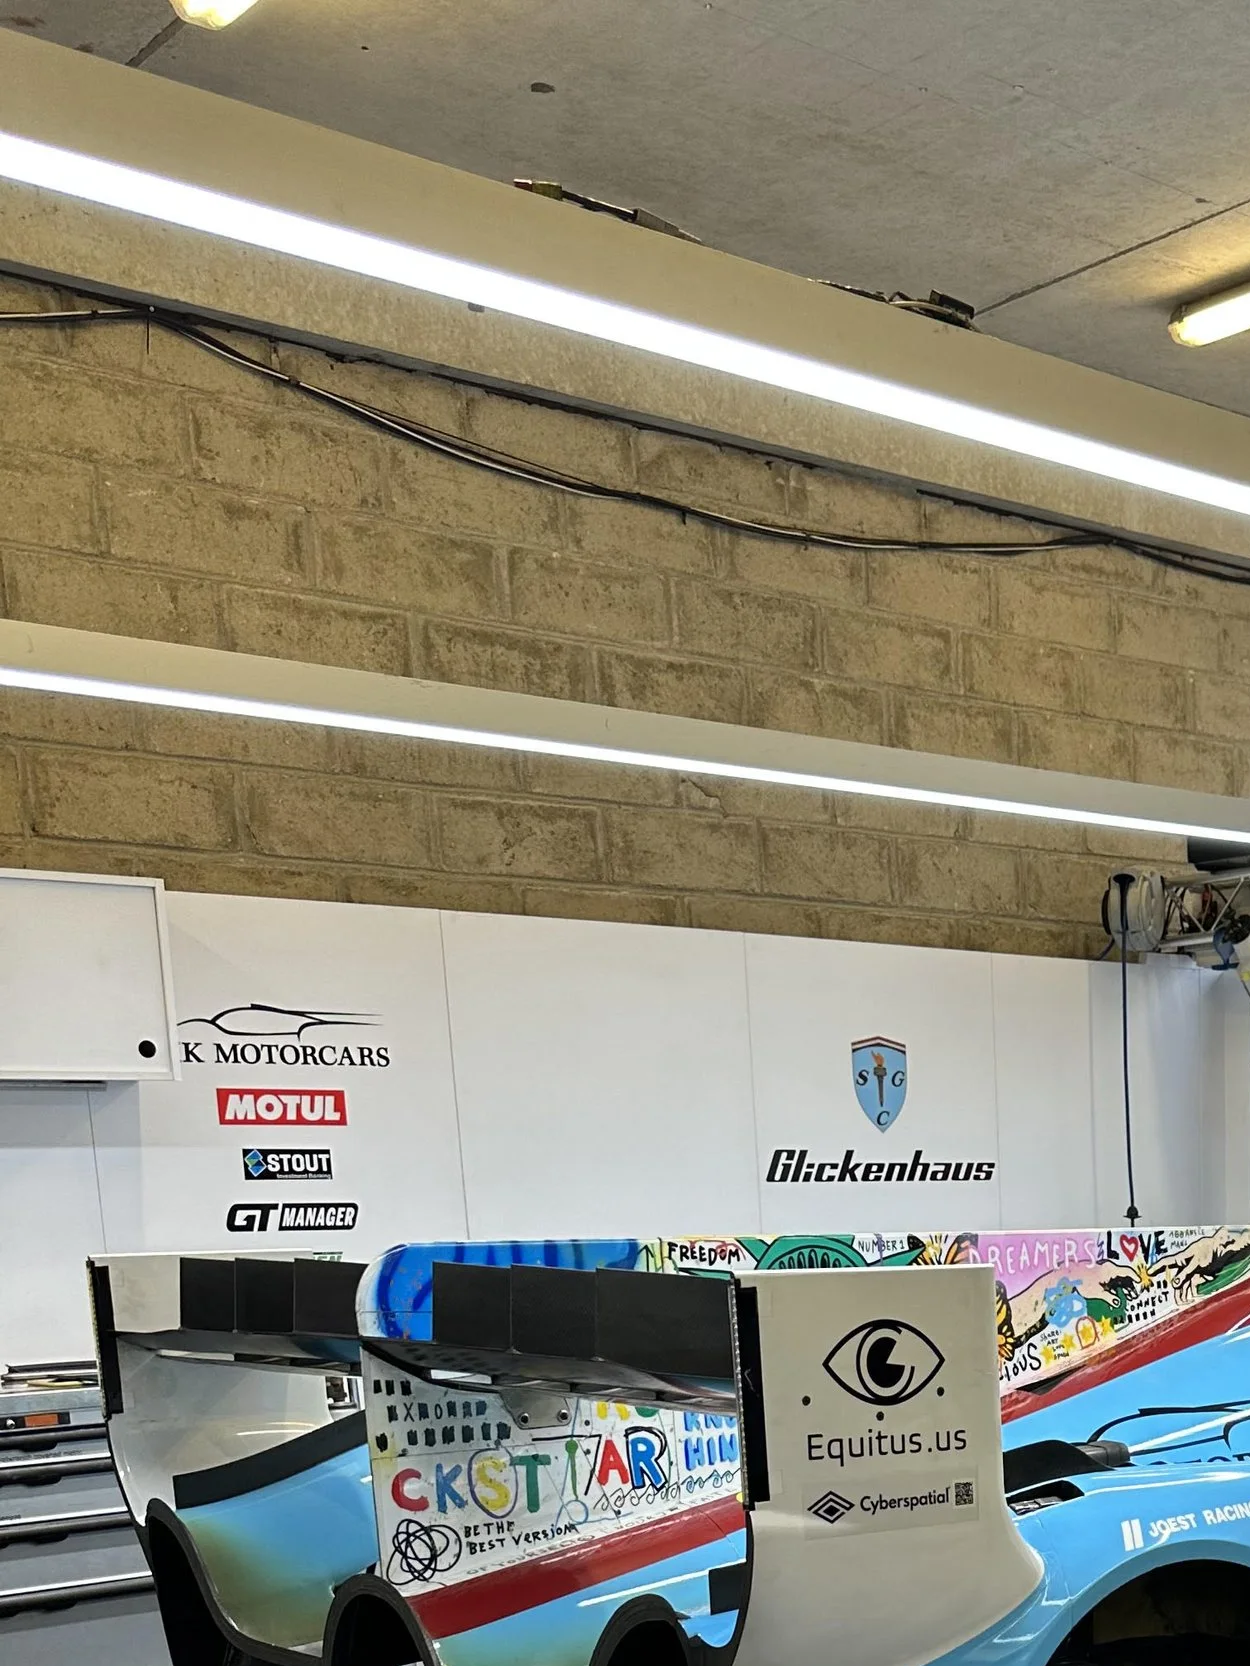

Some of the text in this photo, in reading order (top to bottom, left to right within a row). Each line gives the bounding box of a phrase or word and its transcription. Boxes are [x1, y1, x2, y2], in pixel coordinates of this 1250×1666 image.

[181, 1042, 391, 1067] K MOTORCARS
[225, 1094, 341, 1121] MOTUL
[267, 1154, 329, 1172] STOUT
[766, 1150, 996, 1183] Glickenhaus
[226, 1203, 355, 1232] GT MANAGER
[667, 1242, 740, 1266] FREEDOM
[858, 1240, 897, 1253] NUMBER
[969, 1239, 1097, 1275] DREAMERS
[807, 1429, 967, 1467] Equitus.us
[860, 1487, 949, 1515] Cyberspatial
[464, 1520, 514, 1539] BE THE
[1148, 1513, 1196, 1538] JOEST
[470, 1537, 505, 1556] BEST
